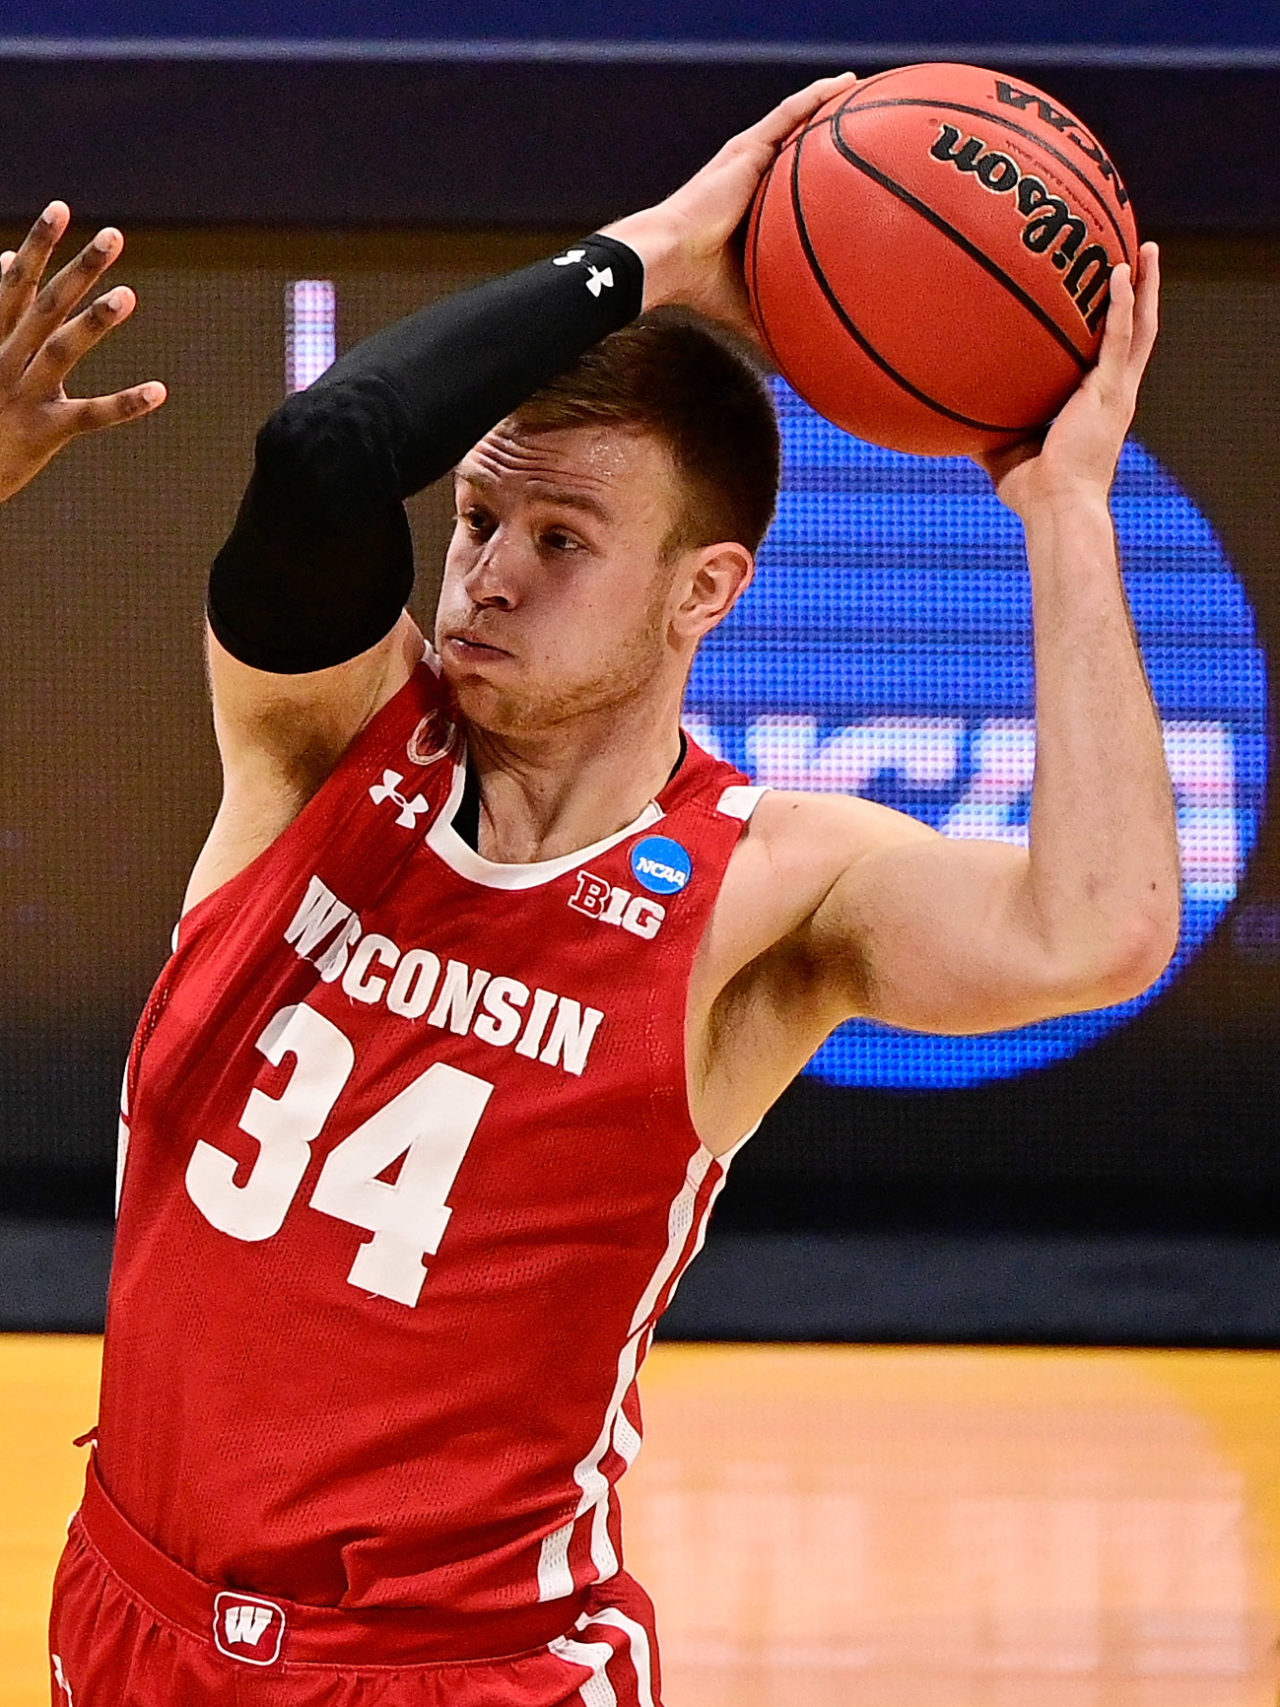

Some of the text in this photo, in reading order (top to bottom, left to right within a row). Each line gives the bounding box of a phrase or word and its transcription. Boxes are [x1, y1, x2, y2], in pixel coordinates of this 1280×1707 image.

[928, 123, 1114, 338] Wilson
[635, 856, 688, 888] NCAA
[283, 874, 604, 1077] WISCONSIN
[185, 1002, 495, 1309] 34
[224, 1604, 275, 1647] W
